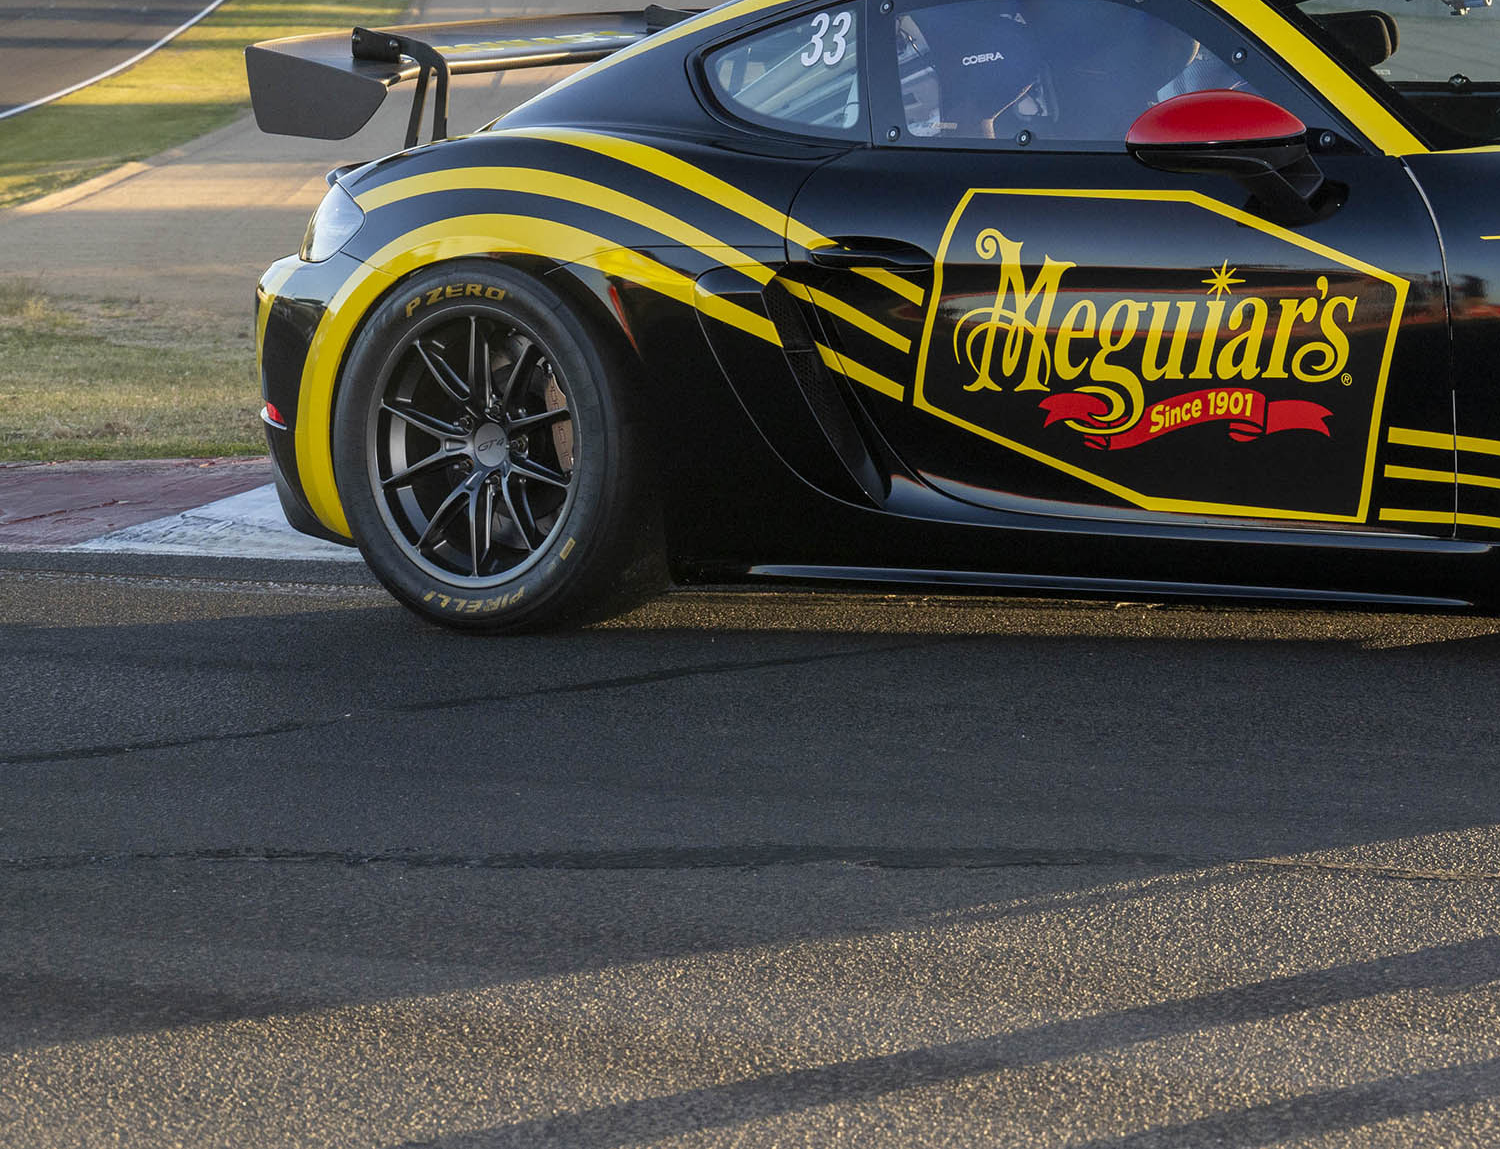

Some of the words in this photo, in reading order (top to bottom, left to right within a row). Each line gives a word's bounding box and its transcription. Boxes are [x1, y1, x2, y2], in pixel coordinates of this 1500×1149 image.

[801, 12, 853, 67] 33
[962, 51, 1005, 66] COBRA
[405, 296, 421, 317] P
[425, 283, 507, 305] ZERO
[953, 227, 1359, 434] Meguiar's
[1149, 400, 1202, 433] Since
[1207, 392, 1254, 418] 1901
[423, 585, 526, 613] PIRELLI
